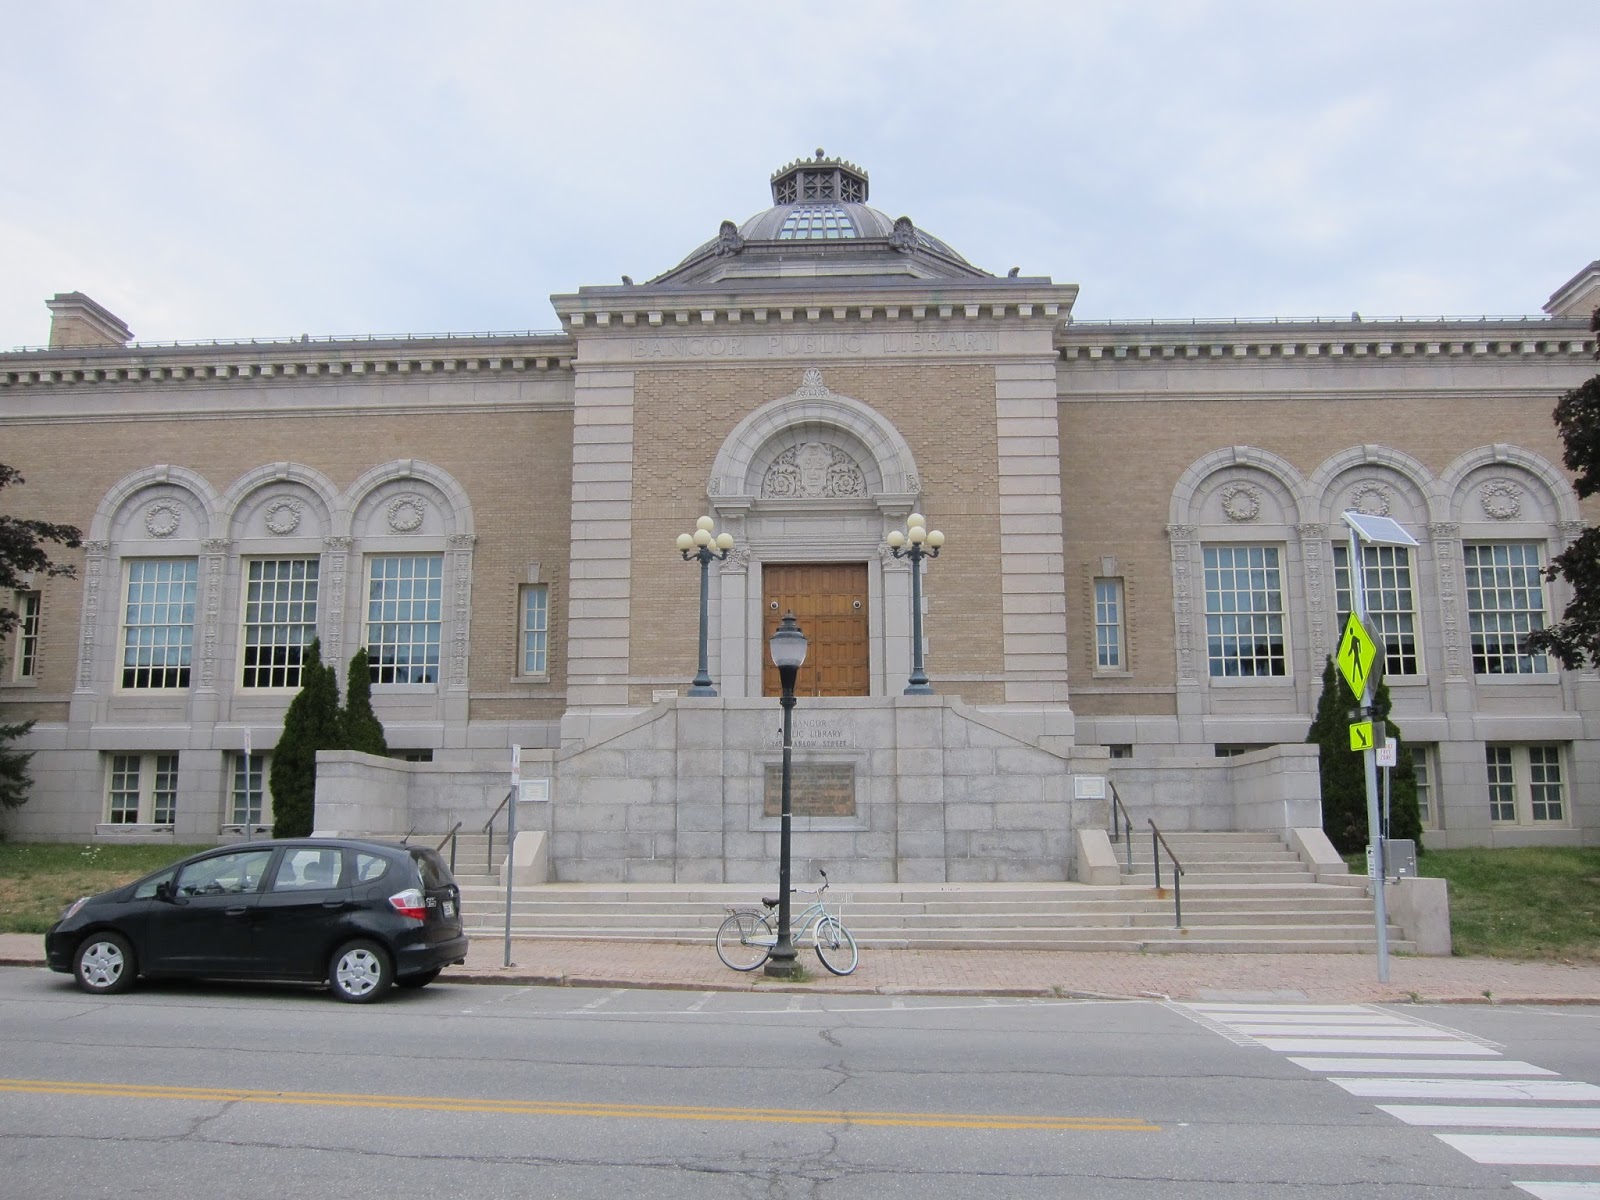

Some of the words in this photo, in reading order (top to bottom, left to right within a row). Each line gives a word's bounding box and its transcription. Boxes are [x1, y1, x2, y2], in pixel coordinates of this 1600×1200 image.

[768, 335, 862, 355] PUBLIC
[883, 332, 994, 353] LIBRARY
[810, 730, 842, 738] LIBRARY
[791, 740, 817, 748] ARLOW
[822, 740, 847, 748] STREET
